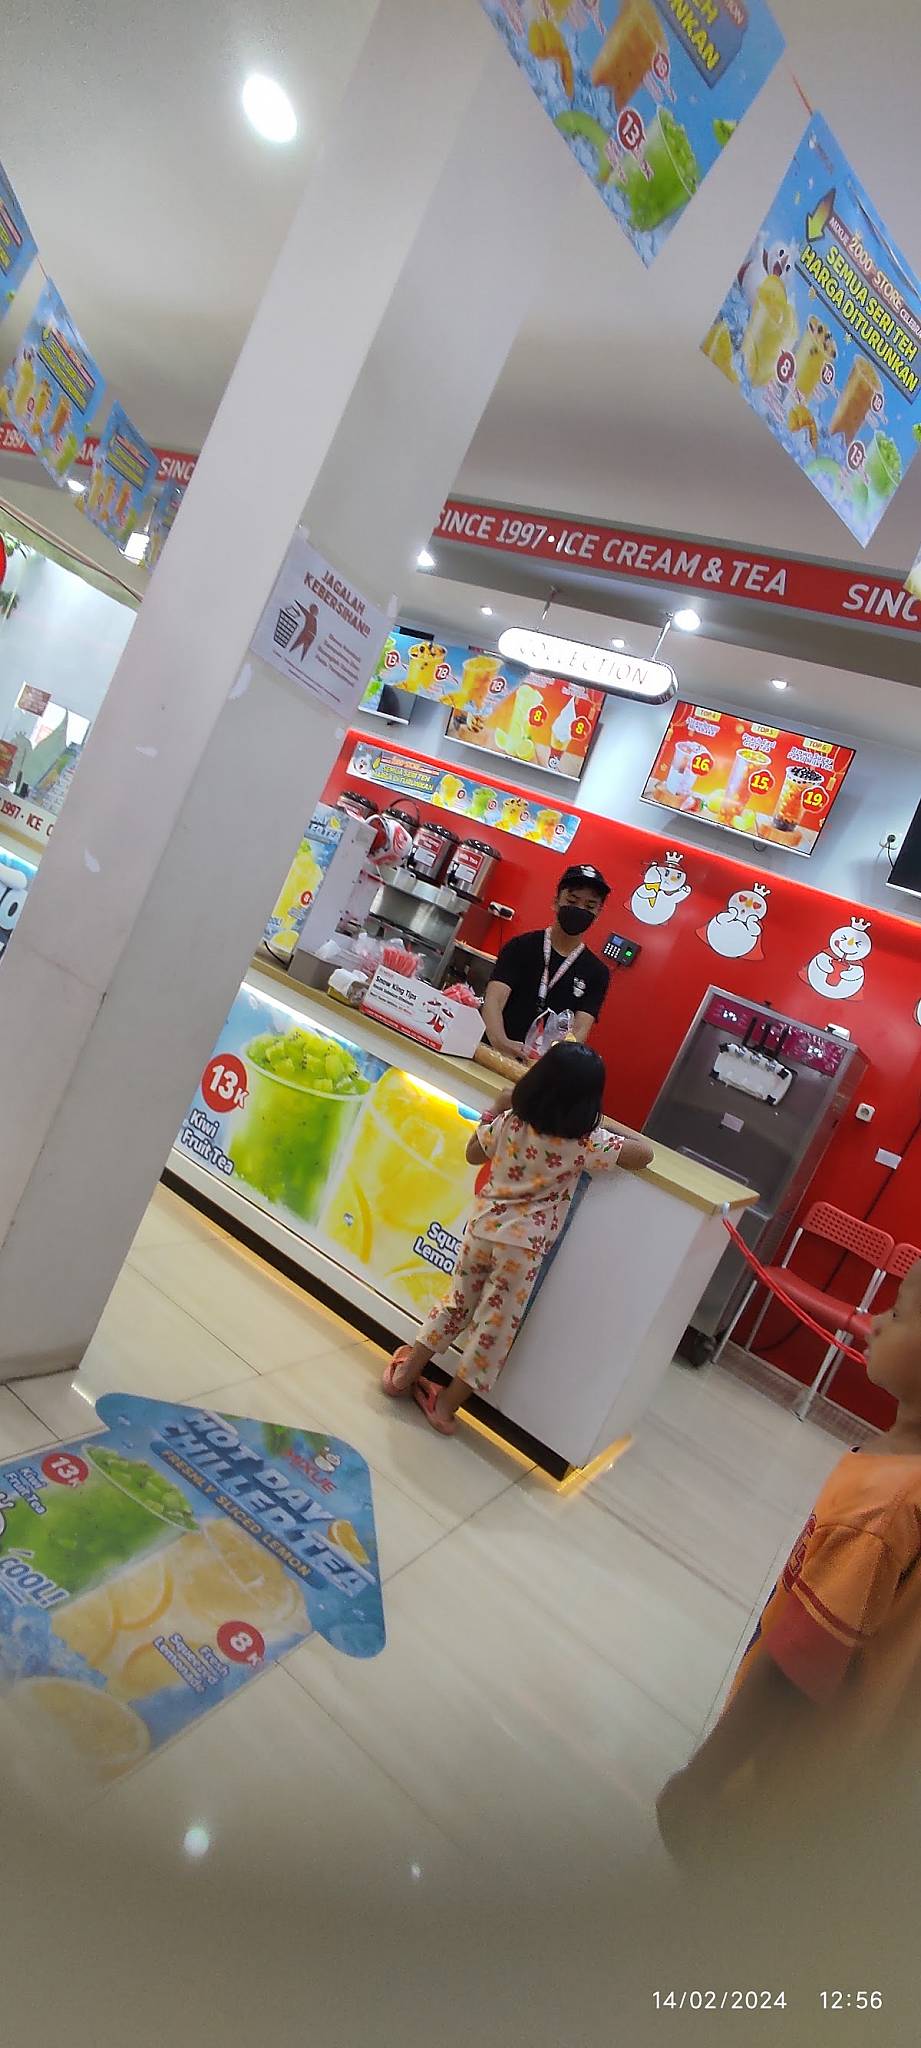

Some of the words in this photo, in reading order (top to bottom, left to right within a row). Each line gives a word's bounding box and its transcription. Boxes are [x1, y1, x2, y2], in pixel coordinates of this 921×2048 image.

[622, 115, 641, 145] 13
[849, 236, 873, 272] 2000
[873, 269, 903, 311] STORE
[800, 245, 844, 309] HARGA
[841, 299, 920, 393] DITURUNKAN
[826, 245, 868, 307] SEMUA
[865, 297, 895, 337] SERI
[893, 325, 919, 363] TEH
[780, 357, 792, 379] 8
[850, 448, 863, 465] 13
[495, 518, 548, 551] 1997
[553, 529, 602, 561] ICE
[602, 538, 702, 580] CREAM
[700, 556, 725, 584] &
[728, 559, 788, 598] TEA
[321, 569, 366, 616] JAGALAH
[437, 666, 449, 679] 18
[491, 680, 504, 693] 18
[1, 800, 21, 820] 1997
[26, 812, 44, 832] ICE
[392, 983, 405, 995] King
[405, 989, 417, 1000] Tips
[189, 1109, 219, 1140] Kiwi
[181, 1127, 212, 1158] Fruit
[210, 1145, 234, 1176] Tea
[183, 1410, 264, 1466] HOT
[19, 1466, 47, 1489] Kiwi
[252, 1467, 336, 1522] DAY
[158, 1422, 298, 1533] CHILLED
[287, 1528, 376, 1598] TEA
[161, 1450, 218, 1495] FRESHLY
[215, 1494, 264, 1535] SLICED
[261, 1534, 312, 1578] LEMON
